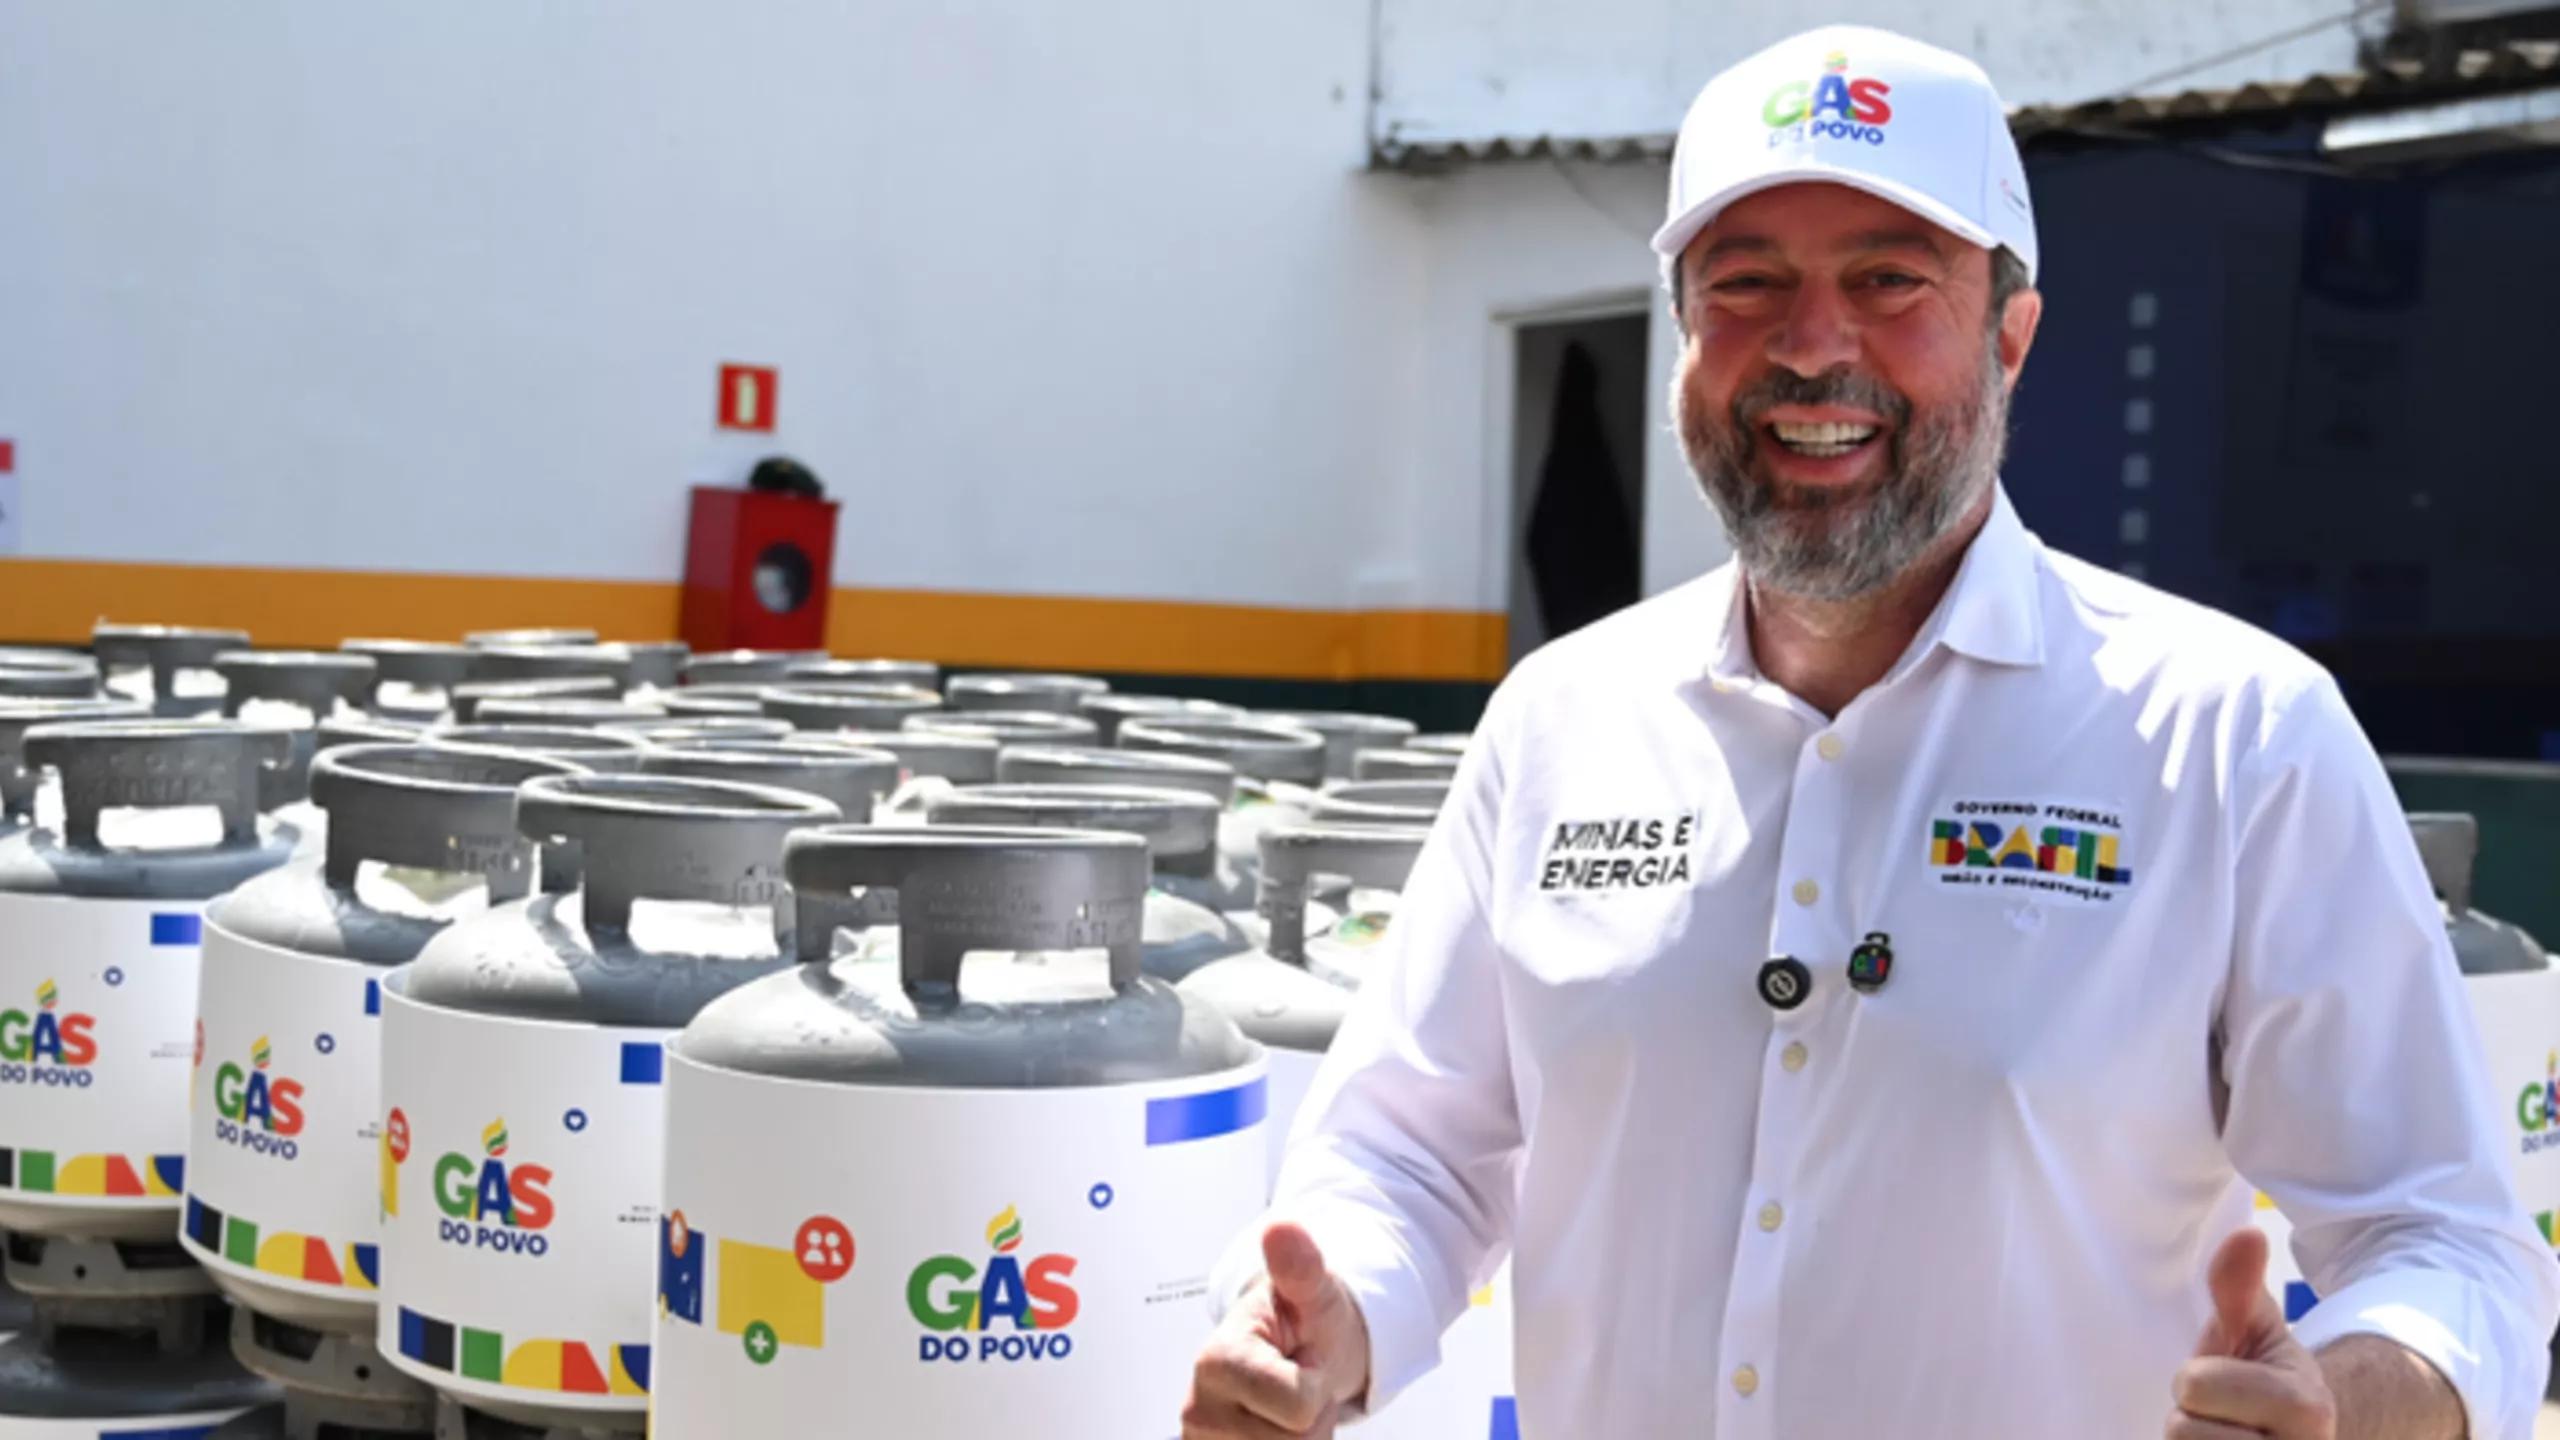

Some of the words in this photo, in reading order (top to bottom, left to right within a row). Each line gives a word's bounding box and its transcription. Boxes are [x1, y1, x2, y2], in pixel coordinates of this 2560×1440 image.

[1811, 120, 1884, 146] POVO
[1954, 801, 2038, 815] GOVERNO
[2045, 805, 2121, 829] FEDERAL
[1552, 818, 1663, 851] MINAS
[1931, 818, 2132, 885] BRASIL
[1540, 853, 1690, 889] ENERGIA
[1, 1064, 26, 1084] DO
[32, 1066, 93, 1088] POVO
[216, 1118, 238, 1145] DO
[241, 1129, 298, 1160] POVO
[439, 1218, 471, 1244] DO
[476, 1227, 548, 1257] POVO
[920, 1336, 970, 1362] DO
[980, 1333, 1073, 1361] POVO
